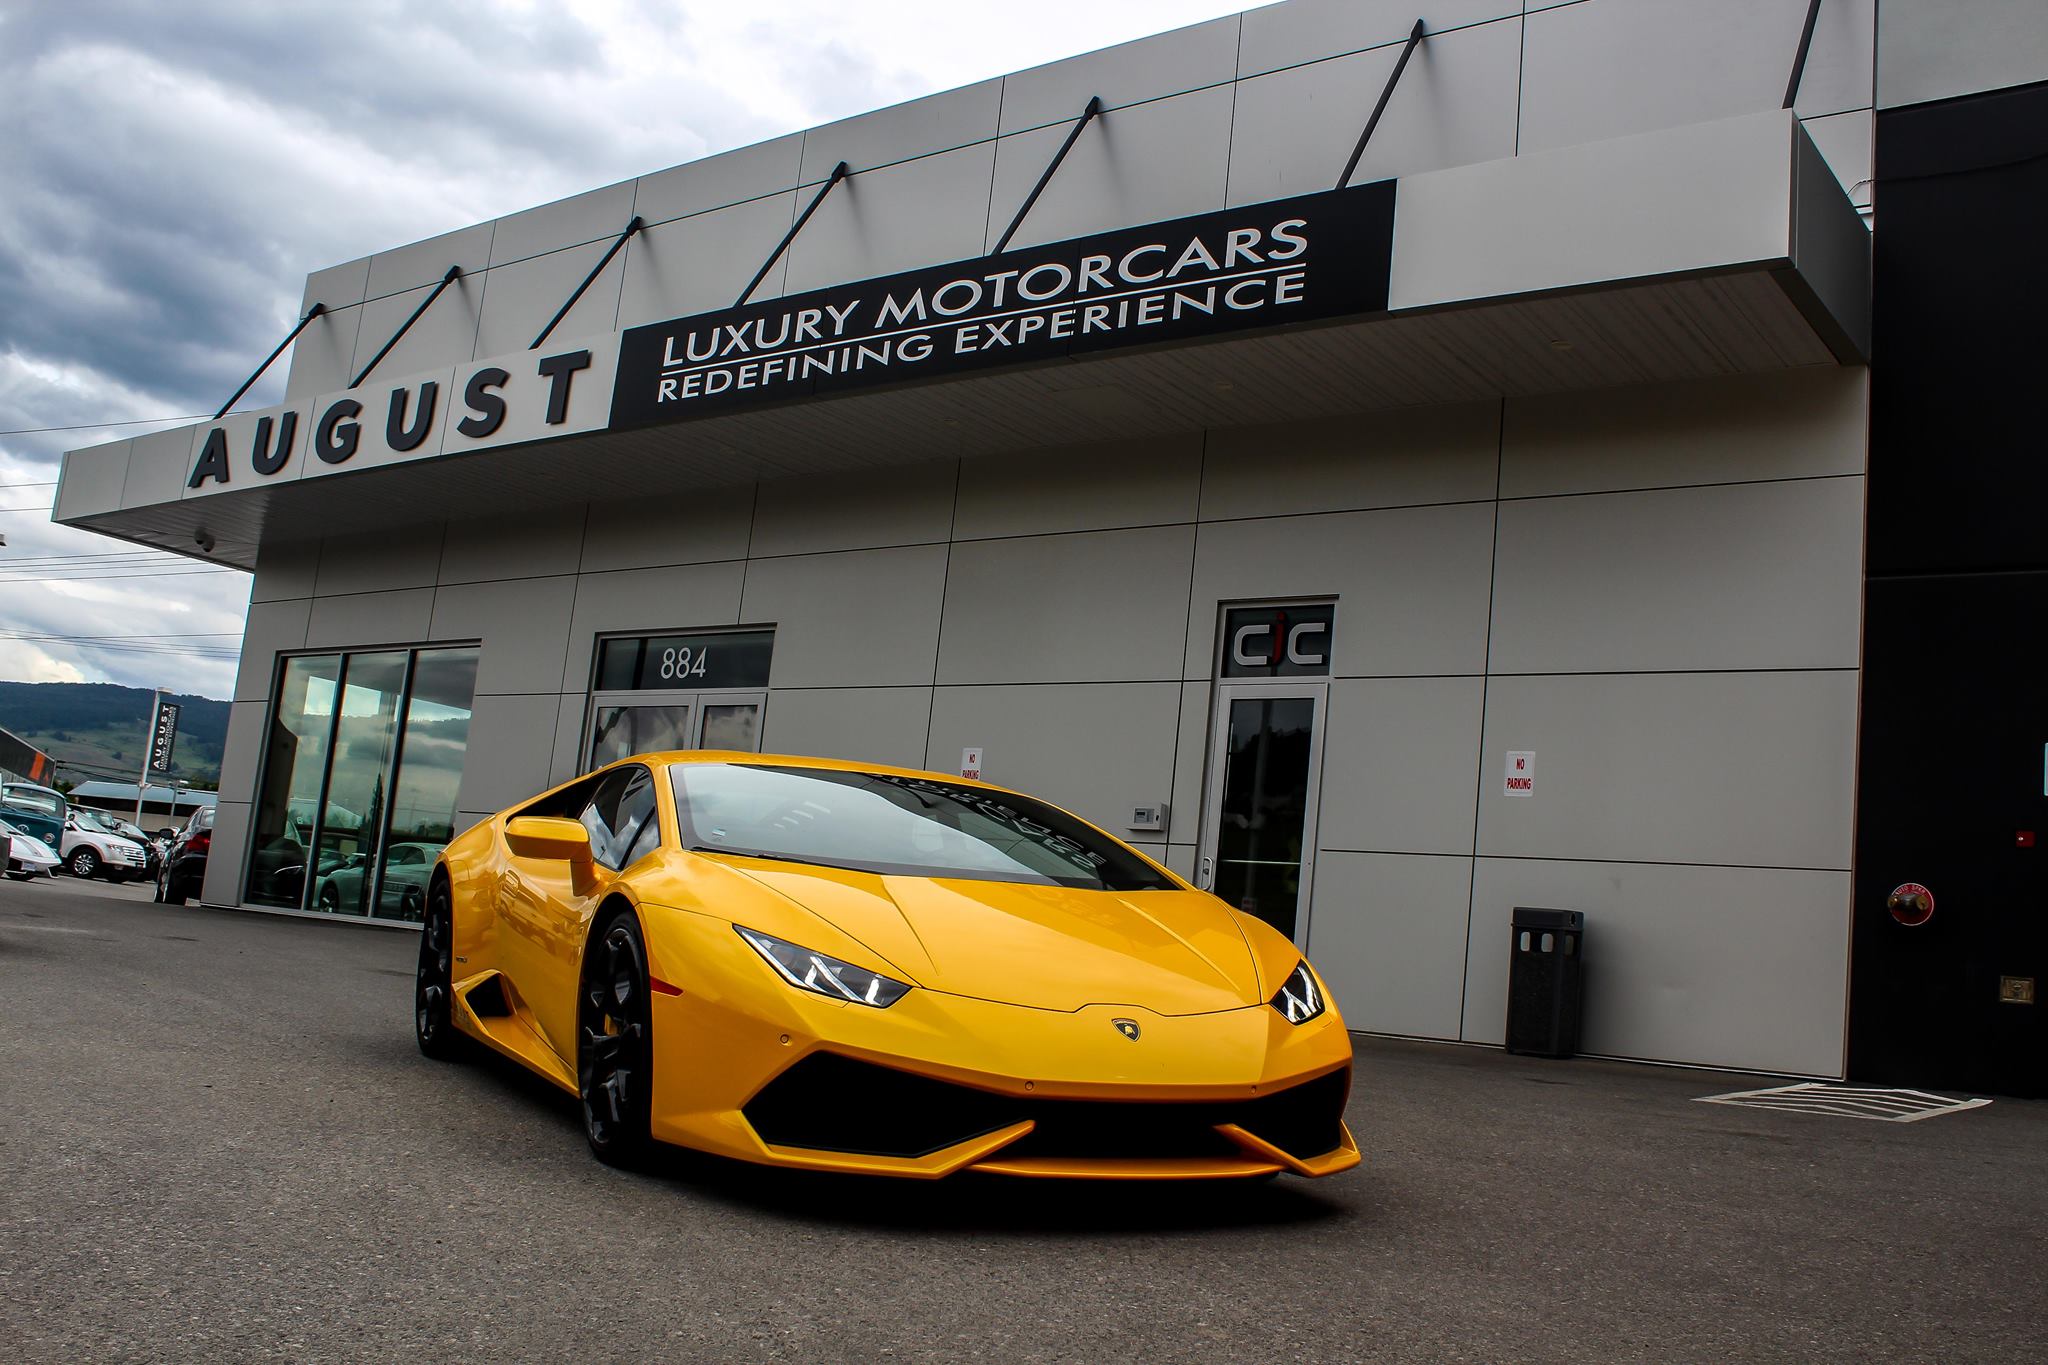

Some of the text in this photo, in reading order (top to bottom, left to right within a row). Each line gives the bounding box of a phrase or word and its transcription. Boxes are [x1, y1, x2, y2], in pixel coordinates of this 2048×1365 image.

[662, 218, 1309, 367] LUXURY MOTORCARS
[657, 271, 1306, 403] REDEFINING EXPERIENCE
[187, 349, 592, 488] AUGUST
[660, 646, 707, 679] 884
[153, 705, 169, 769] AUGUST
[968, 753, 976, 764] NO
[1506, 777, 1532, 790] PARKING
[1515, 758, 1525, 770] NO
